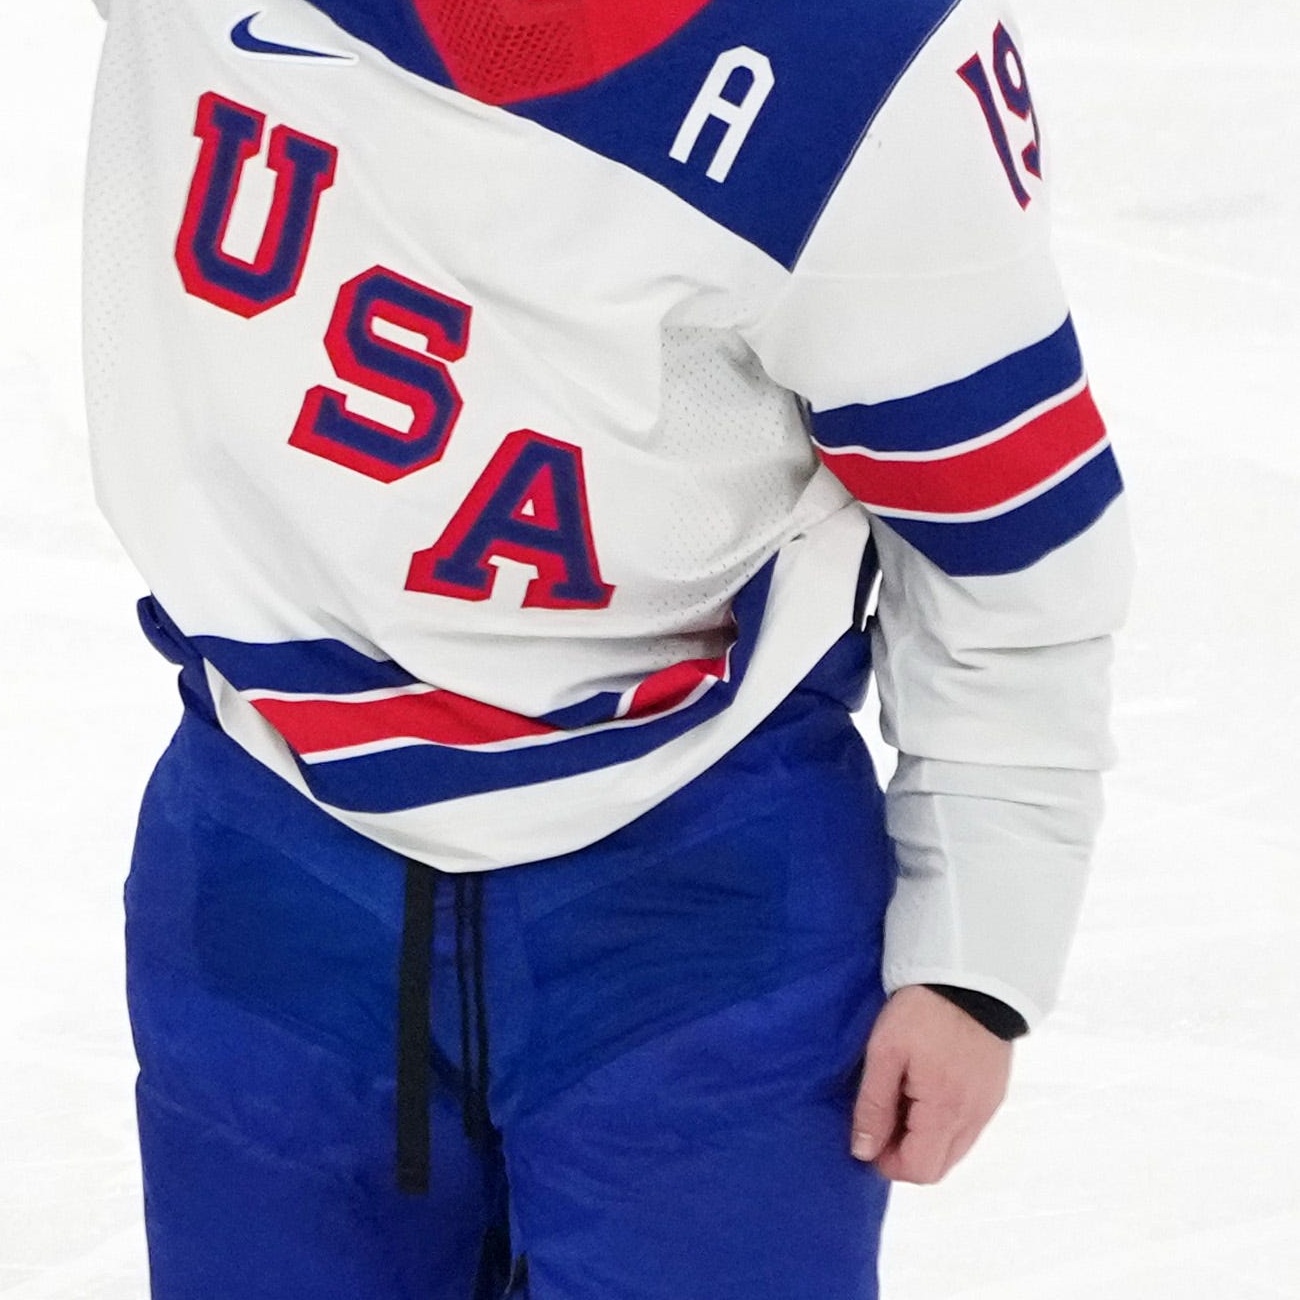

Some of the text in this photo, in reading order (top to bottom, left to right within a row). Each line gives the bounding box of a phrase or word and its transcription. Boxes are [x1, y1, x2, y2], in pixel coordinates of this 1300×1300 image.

[668, 45, 776, 184] A
[955, 19, 1043, 212] 19
[174, 90, 617, 611] USA
